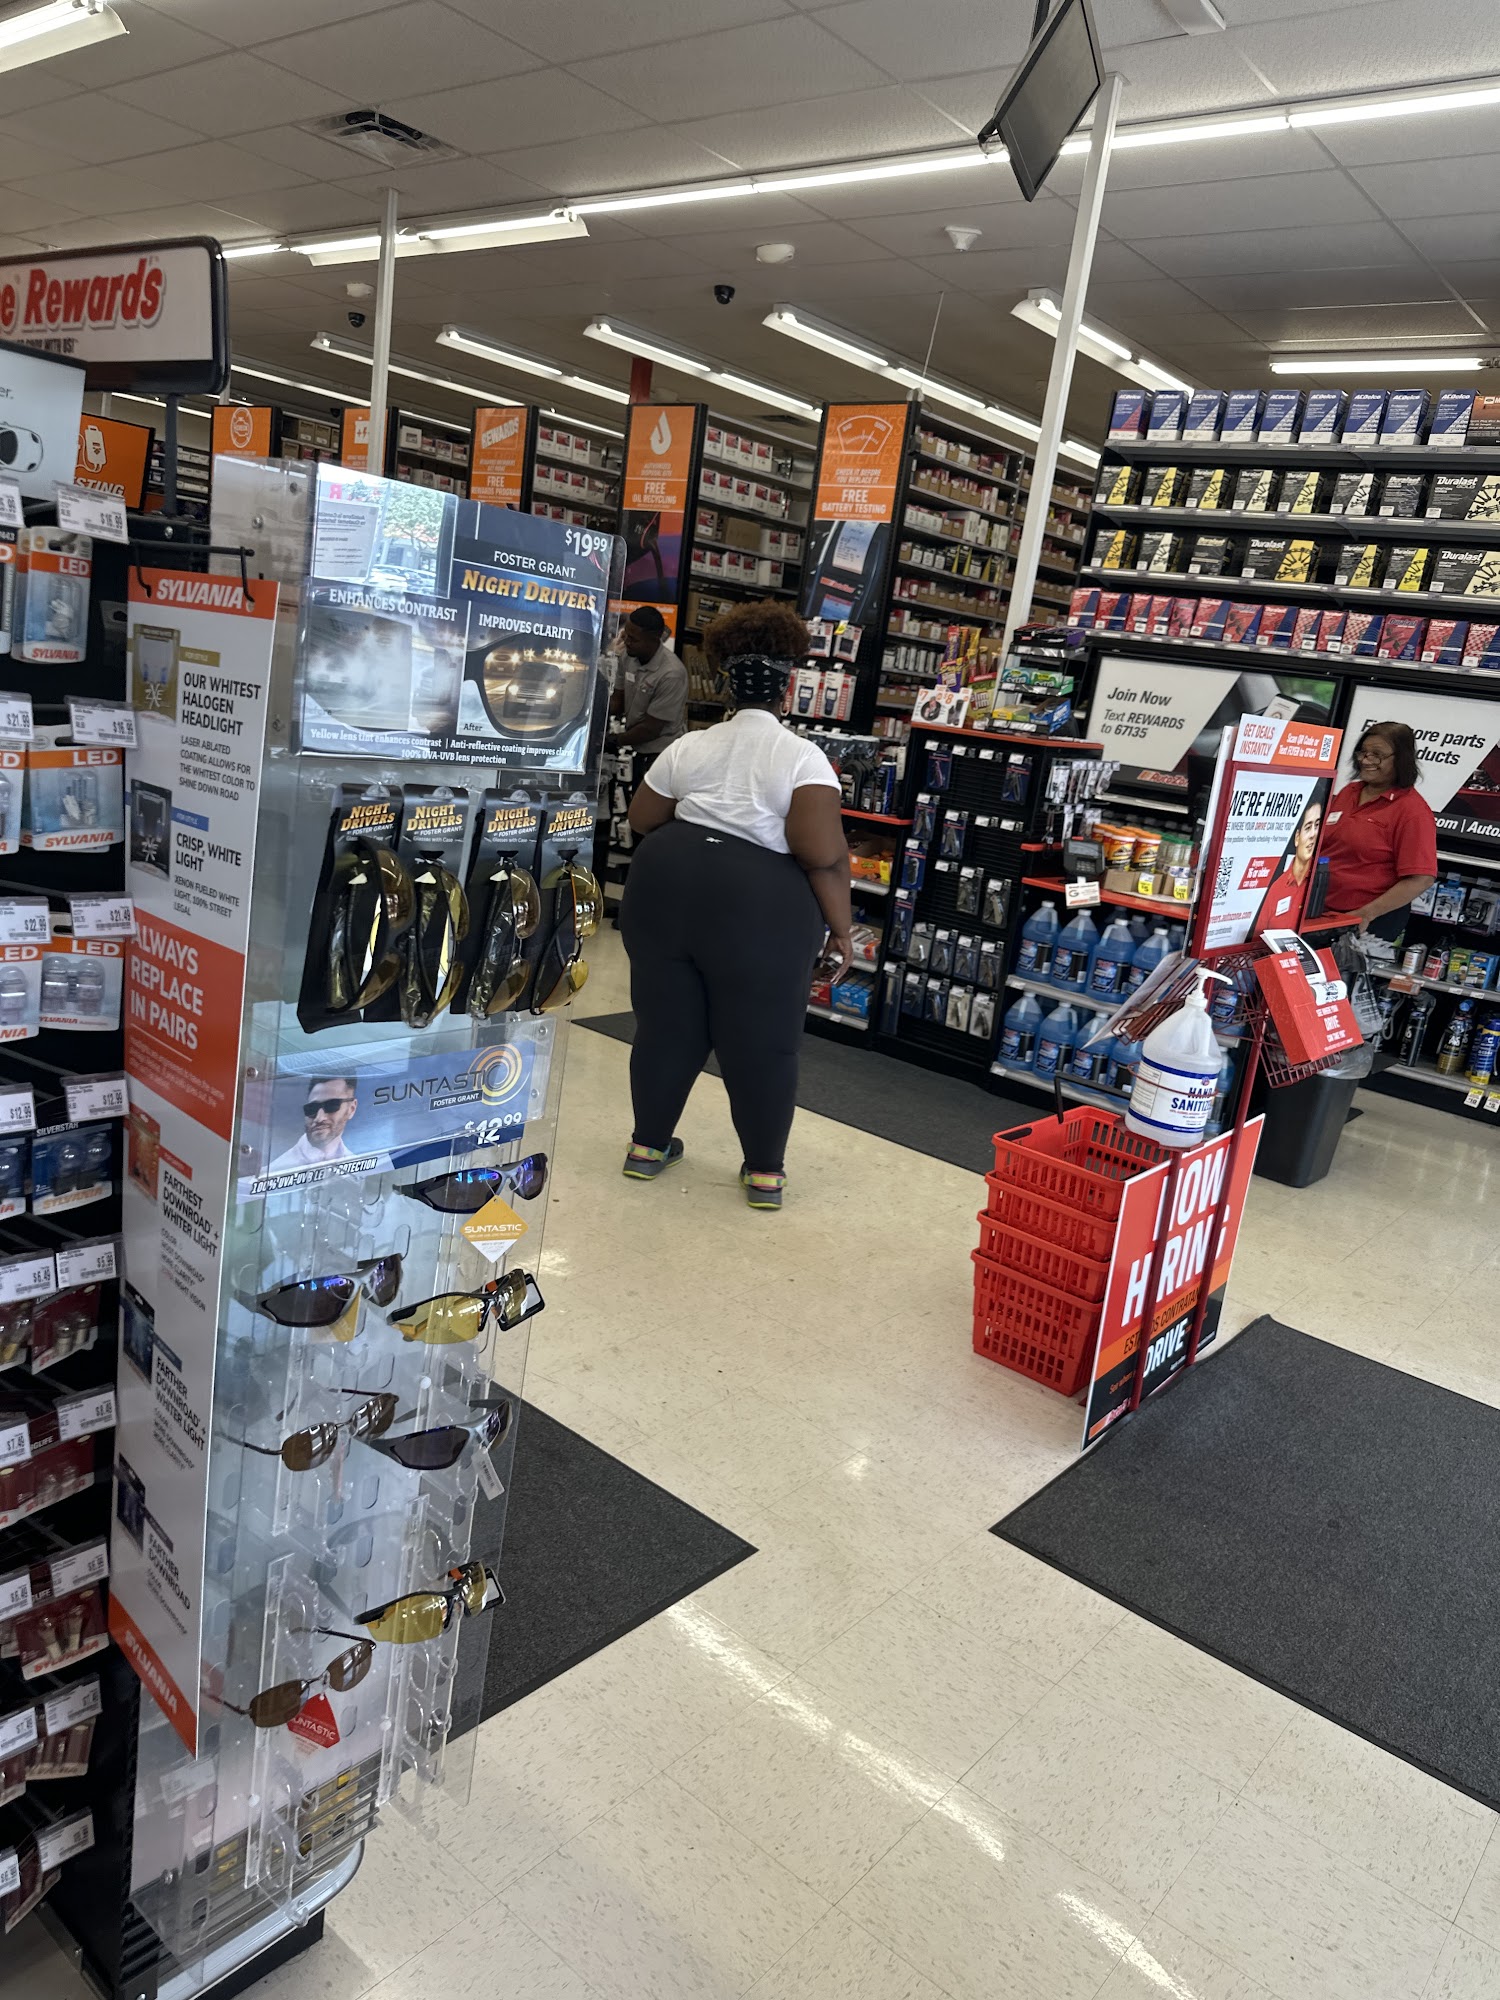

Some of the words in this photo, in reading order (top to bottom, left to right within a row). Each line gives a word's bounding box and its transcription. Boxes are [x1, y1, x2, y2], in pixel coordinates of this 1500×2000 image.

[24, 258, 163, 325] Rewards
[481, 417, 520, 449] REWARDS
[487, 476, 505, 487] FREE
[644, 482, 666, 494] FREE
[1436, 476, 1479, 486] Duralast
[842, 489, 869, 503] FREE
[822, 502, 854, 513] BATTERY
[854, 503, 887, 514] TESTING
[1250, 539, 1286, 549] Duralast
[493, 550, 536, 571] FOSTER
[538, 560, 577, 579] GRANT
[1442, 550, 1483, 561] Duralast
[59, 557, 89, 575] LED
[156, 578, 244, 609] SYLVANIA
[461, 568, 523, 598] NIGHT
[524, 581, 597, 611] DRIVERS
[329, 588, 396, 614] ENHANCES
[397, 600, 458, 622] CONTRAST
[479, 613, 532, 634] IMPROVES
[532, 622, 574, 641] CLARITY
[32, 648, 80, 660] SYLVANIA
[184, 672, 207, 689] OUR
[210, 676, 262, 700] WHITEST
[182, 691, 234, 714] HALOGEN
[1107, 687, 1137, 702] Join
[1139, 690, 1173, 706] Now
[7, 714, 30, 728] $21.99
[181, 709, 243, 736] HEADLIGHT
[463, 722, 483, 733] After
[1103, 709, 1126, 722] Text
[1127, 712, 1186, 730] REWARDS
[1100, 723, 1112, 734] to
[1114, 725, 1148, 739] 67135
[1243, 723, 1256, 737] GET
[1256, 725, 1276, 740] DEALS
[1413, 727, 1440, 742] ore
[1440, 732, 1486, 749] parts
[181, 735, 201, 747] LASER
[201, 740, 231, 755] ABLATED
[311, 728, 339, 740] Yellow
[340, 731, 357, 742] lens
[358, 732, 374, 742] tint
[375, 733, 410, 745] enhances
[411, 736, 442, 748] contrast
[450, 739, 501, 752] Anti-reflective
[501, 743, 526, 756] coating
[526, 745, 552, 757] improves
[1239, 740, 1272, 756] INSTANTLY
[73, 751, 118, 766] LED
[180, 749, 207, 764] COATING
[208, 756, 236, 772] ALLOWS
[236, 763, 251, 775] FOR
[401, 749, 421, 759] 100%
[421, 750, 455, 761] UVA-UVB
[455, 752, 470, 762] lens
[470, 753, 507, 765] protection
[1416, 747, 1461, 765] ducts
[179, 762, 192, 774] THE
[192, 766, 221, 781] WHITEST
[222, 774, 244, 789] COLOR
[245, 779, 256, 791] TO
[179, 776, 197, 790] SHINE
[198, 781, 219, 795] DOWN
[220, 788, 239, 801] ROAD
[350, 802, 391, 819] NIGHT
[414, 804, 456, 819] NIGHT
[1230, 790, 1265, 817] WE'RE
[1262, 792, 1303, 818] HIRING
[341, 812, 396, 831] DRIVERS
[406, 814, 463, 831] DRIVERS
[495, 806, 531, 822] NIGHT
[555, 807, 589, 823] NIGHT
[352, 826, 374, 835] FOSTER
[374, 824, 395, 833] GRANT
[420, 828, 442, 836] FOSTER
[442, 826, 464, 834] GRANT
[487, 815, 537, 834] DRIVERS
[498, 829, 518, 838] FOSTER
[518, 826, 537, 835] GRANT
[547, 815, 594, 834] DRIVERS
[557, 829, 575, 837] FOSTER
[575, 825, 593, 834] GRANT
[44, 832, 115, 848] SYLVANIA
[176, 832, 206, 857] CRISP,
[207, 842, 242, 867] WHITE
[175, 850, 204, 872] LIGHT
[174, 875, 195, 889] XENON
[195, 881, 217, 899] FUELED
[218, 891, 240, 907] WHITE
[173, 901, 192, 916] LEGAL
[209, 902, 232, 918] STREET
[24, 919, 47, 932] $22.99
[71, 939, 121, 957] LED
[131, 922, 199, 975] ALWAYS
[131, 955, 204, 1016] REPLACE
[131, 989, 146, 1021] IN
[149, 1000, 198, 1050] PAIRS
[103, 1092, 123, 1105] $12.99
[433, 1096, 457, 1108] FOSTER
[457, 1092, 480, 1103] GRANT
[1188, 1087, 1213, 1099] HAND
[10, 1106, 32, 1119] $12.99
[1171, 1097, 1212, 1112] SANITIZE
[36, 1121, 79, 1137] SILVERSTAR
[163, 1170, 203, 1210] FARTHEST
[251, 1176, 278, 1194] 100%
[278, 1169, 313, 1189] UVA-UVB
[162, 1202, 193, 1239] WHITER
[193, 1231, 218, 1258] LIGHT
[464, 1222, 523, 1235] SUNTASTIC
[1142, 1318, 1189, 1379] DRIVE
[157, 1357, 188, 1400] FARTHER
[155, 1386, 183, 1426] WHITER
[183, 1417, 205, 1451] LIGHT
[149, 1533, 180, 1581] FARTHER
[148, 1548, 191, 1611] DOWNROAD
[124, 1630, 178, 1715] SYLVANIA
